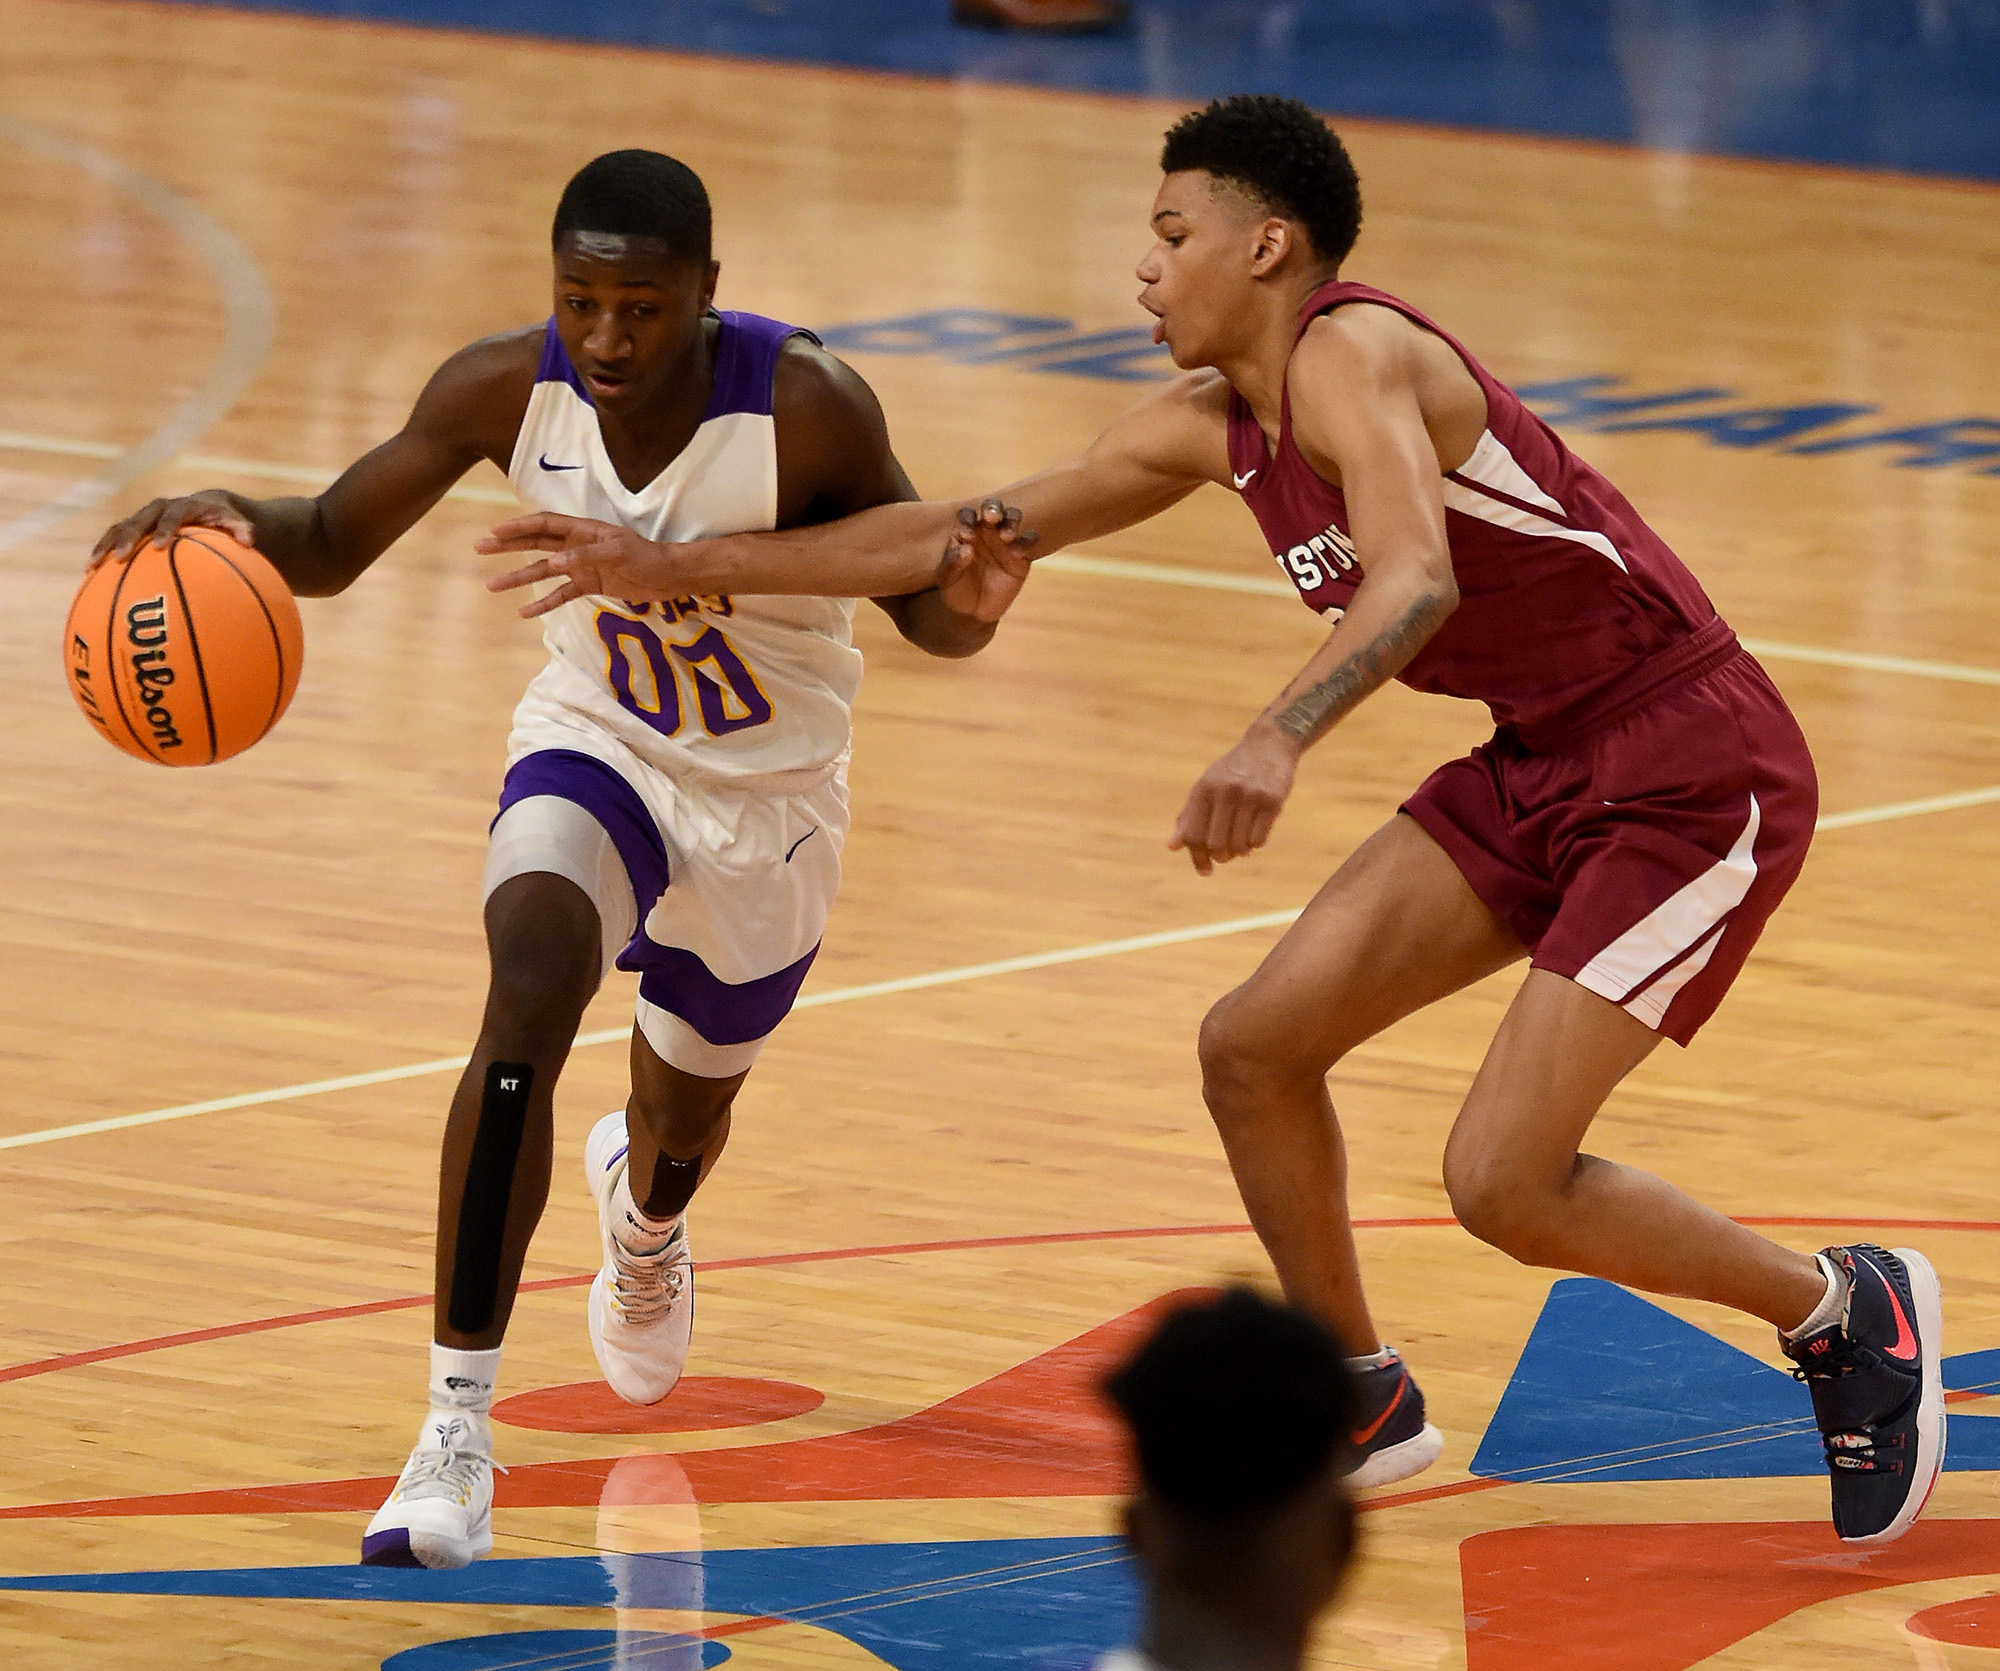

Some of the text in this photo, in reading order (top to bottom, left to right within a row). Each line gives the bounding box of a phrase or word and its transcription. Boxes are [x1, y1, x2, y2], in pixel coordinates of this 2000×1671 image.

[1512, 371, 2000, 478] HAR
[126, 594, 183, 749] Wilson
[593, 606, 775, 738] 00
[500, 1076, 519, 1091] KT
